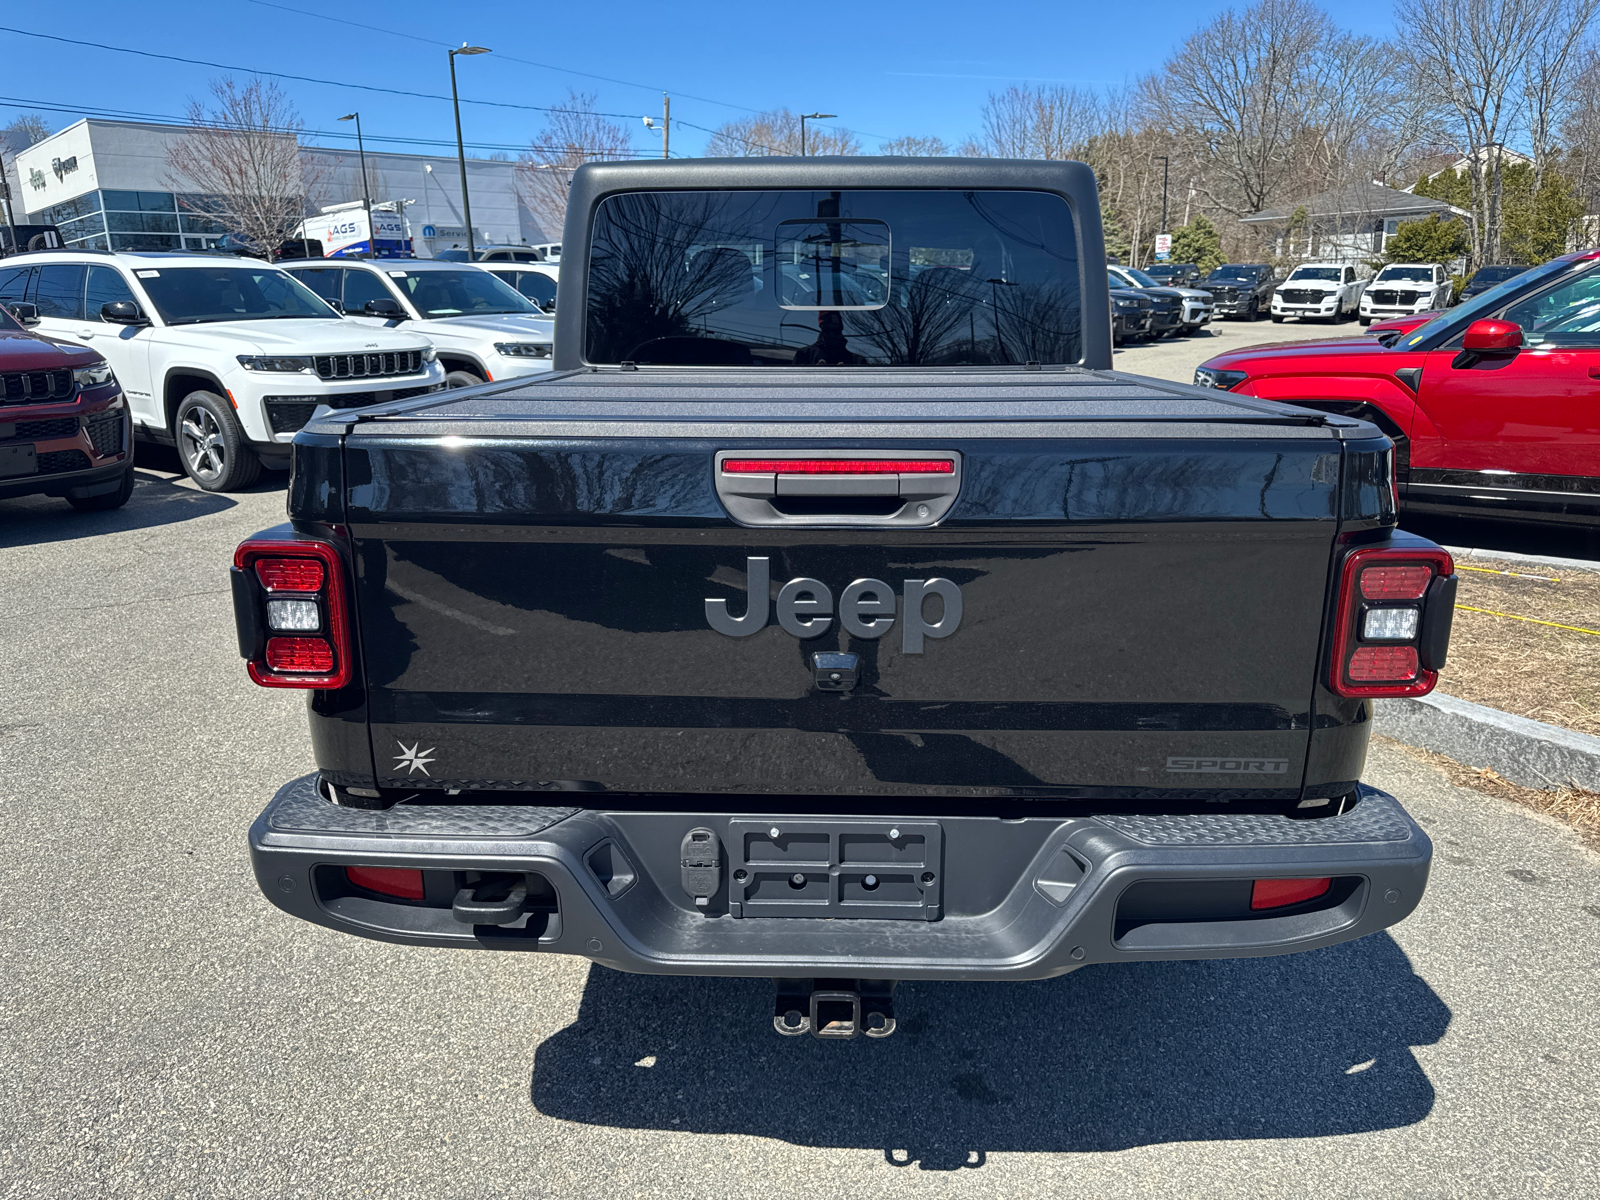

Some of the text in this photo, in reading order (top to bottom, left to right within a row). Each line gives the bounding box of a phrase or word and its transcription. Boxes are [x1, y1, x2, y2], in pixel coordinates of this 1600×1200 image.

[333, 223, 355, 235] AGS
[380, 223, 401, 231] AGS
[440, 229, 474, 237] Servic
[705, 556, 963, 654] Jeep
[1166, 759, 1290, 772] SPORT
